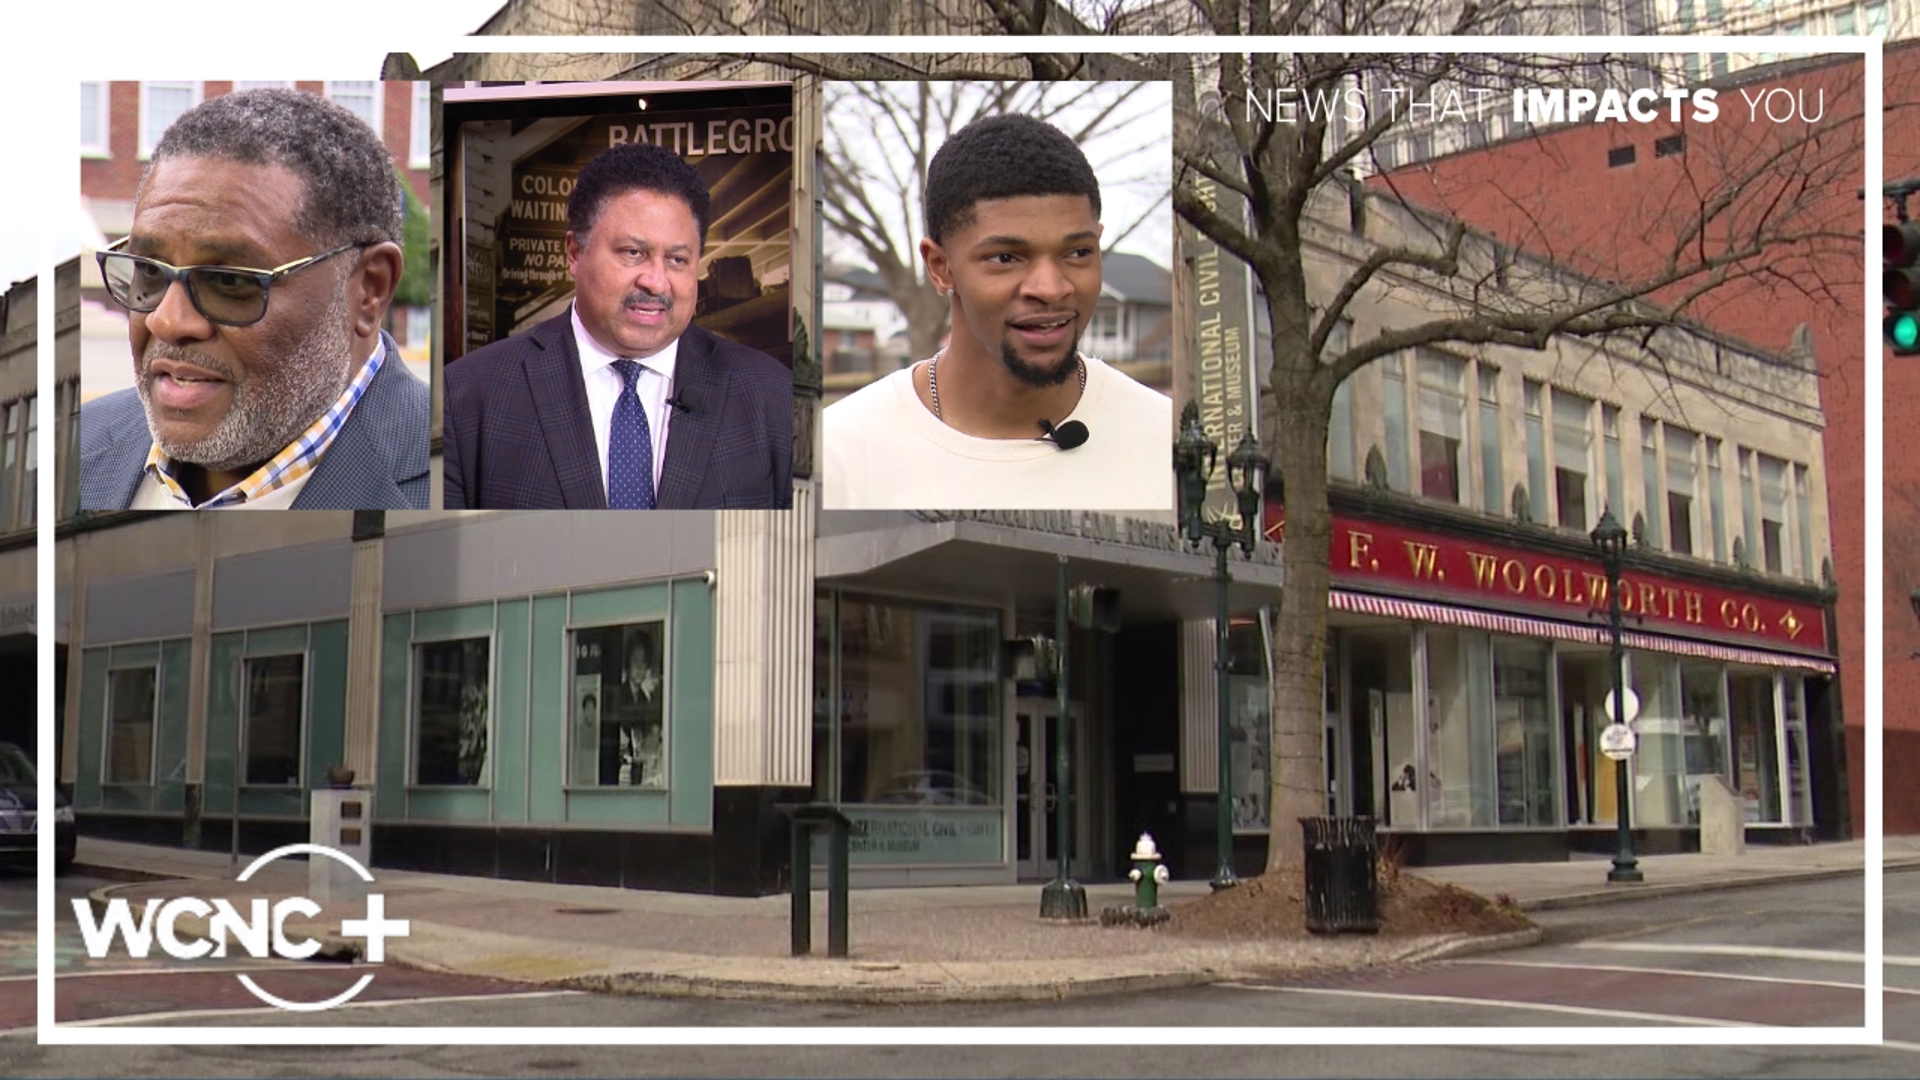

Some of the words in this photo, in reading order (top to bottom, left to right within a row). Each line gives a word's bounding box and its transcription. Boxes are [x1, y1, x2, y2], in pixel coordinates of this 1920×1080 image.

[521, 174, 577, 196] COLO
[511, 198, 569, 222] WAITIN
[509, 237, 561, 253] PRIVATE
[523, 253, 544, 267] NO
[1224, 326, 1242, 400] MUSEUM
[1347, 530, 1379, 571] F.
[1403, 540, 1445, 581] W.
[1466, 551, 1705, 625] WOOLWORTH
[1721, 599, 1767, 633] CO.
